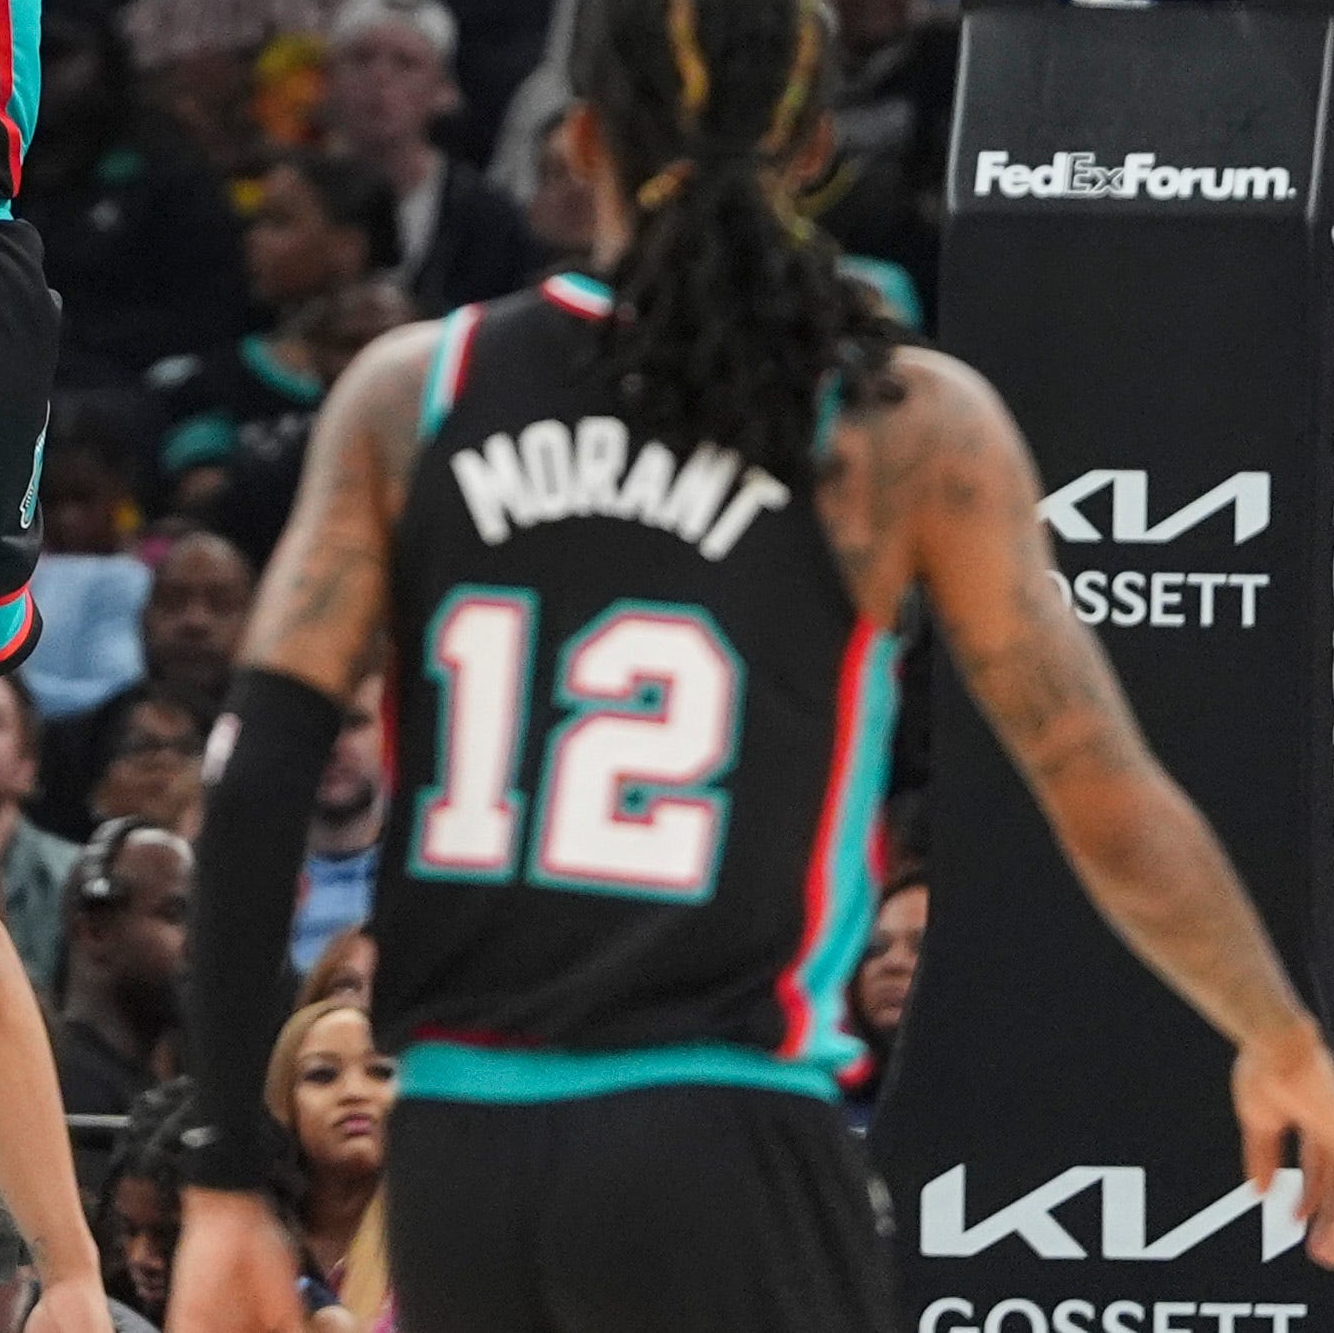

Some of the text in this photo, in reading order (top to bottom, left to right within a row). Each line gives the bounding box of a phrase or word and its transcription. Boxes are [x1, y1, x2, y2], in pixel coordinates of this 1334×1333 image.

[450, 415, 791, 561] MORANT
[1045, 570, 1270, 628] SSETT
[407, 582, 748, 907] 12
[921, 1163, 1307, 1263] KIA
